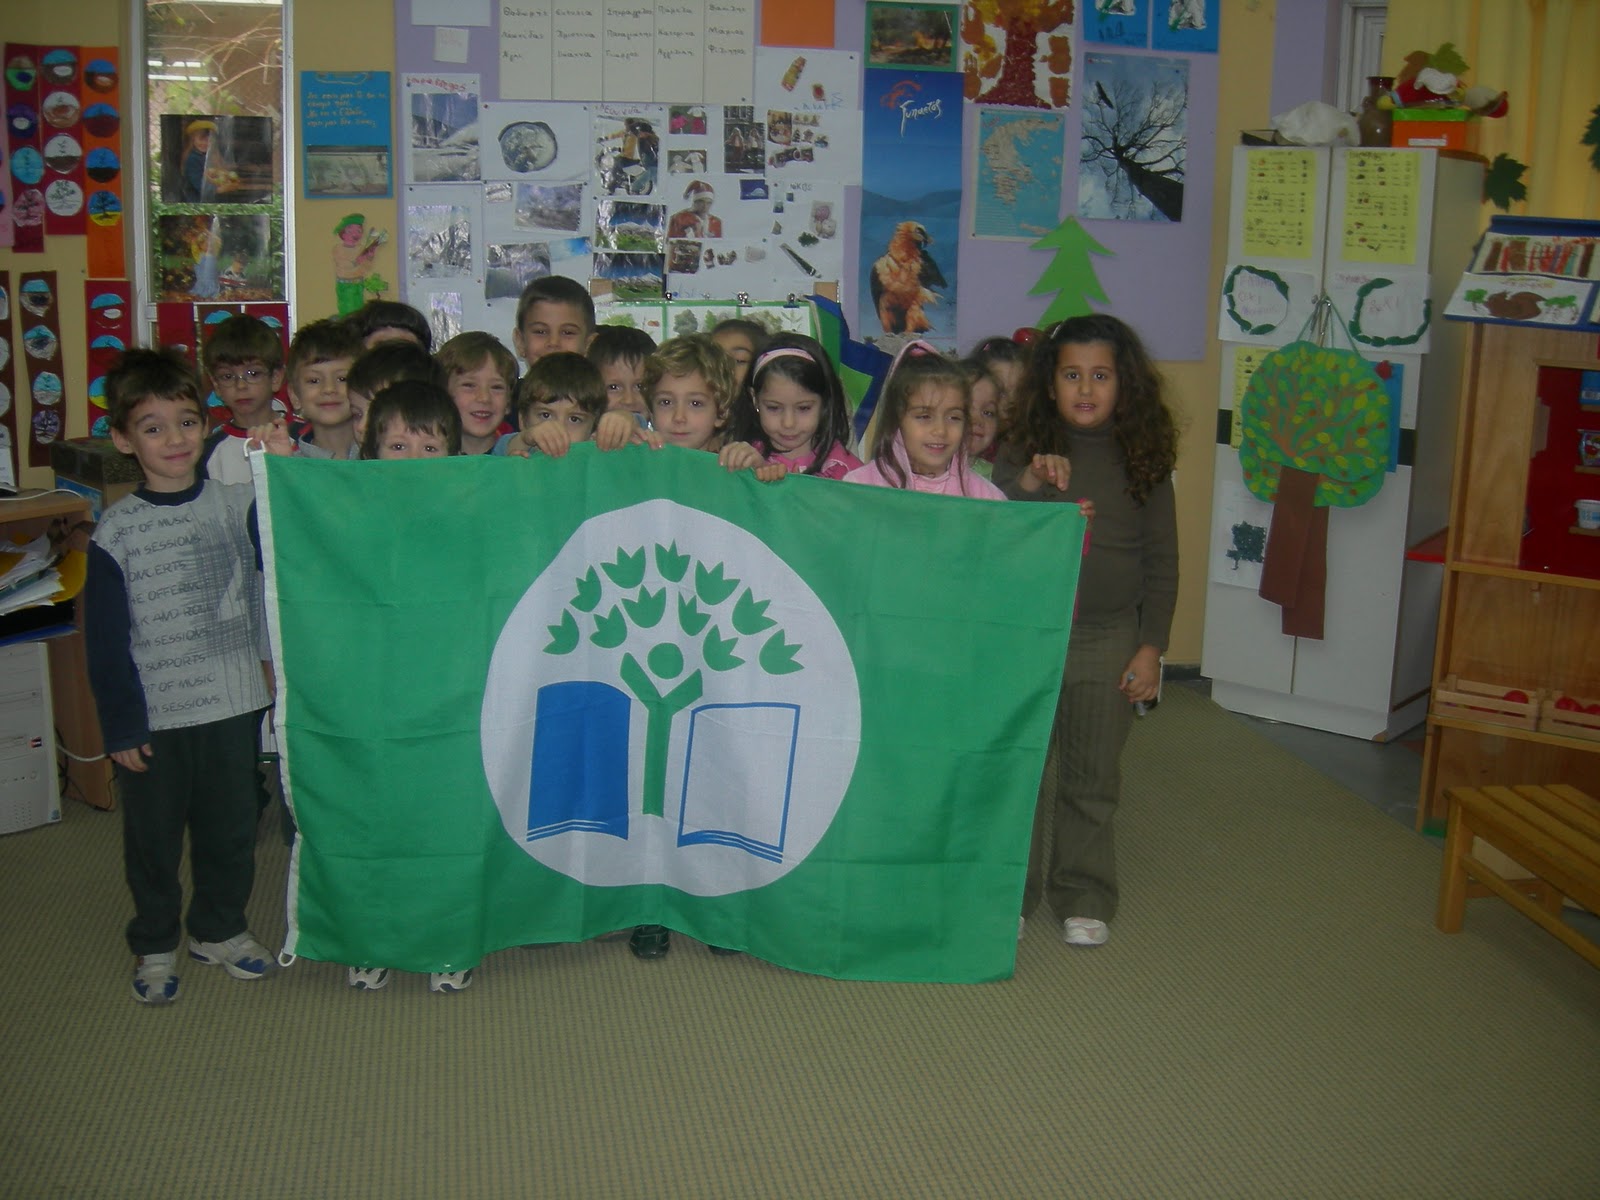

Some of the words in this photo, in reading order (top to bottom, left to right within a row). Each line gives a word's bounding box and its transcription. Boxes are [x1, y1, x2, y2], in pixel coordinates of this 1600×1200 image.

[138, 520, 153, 533] OF
[157, 513, 193, 528] MUSIC
[143, 535, 202, 555] SESSIONS
[152, 608, 180, 622] AND
[144, 654, 207, 672] SUPPORTS
[158, 681, 175, 692] OF
[178, 672, 217, 689] MUSIC
[161, 694, 221, 713] SESSIONS
